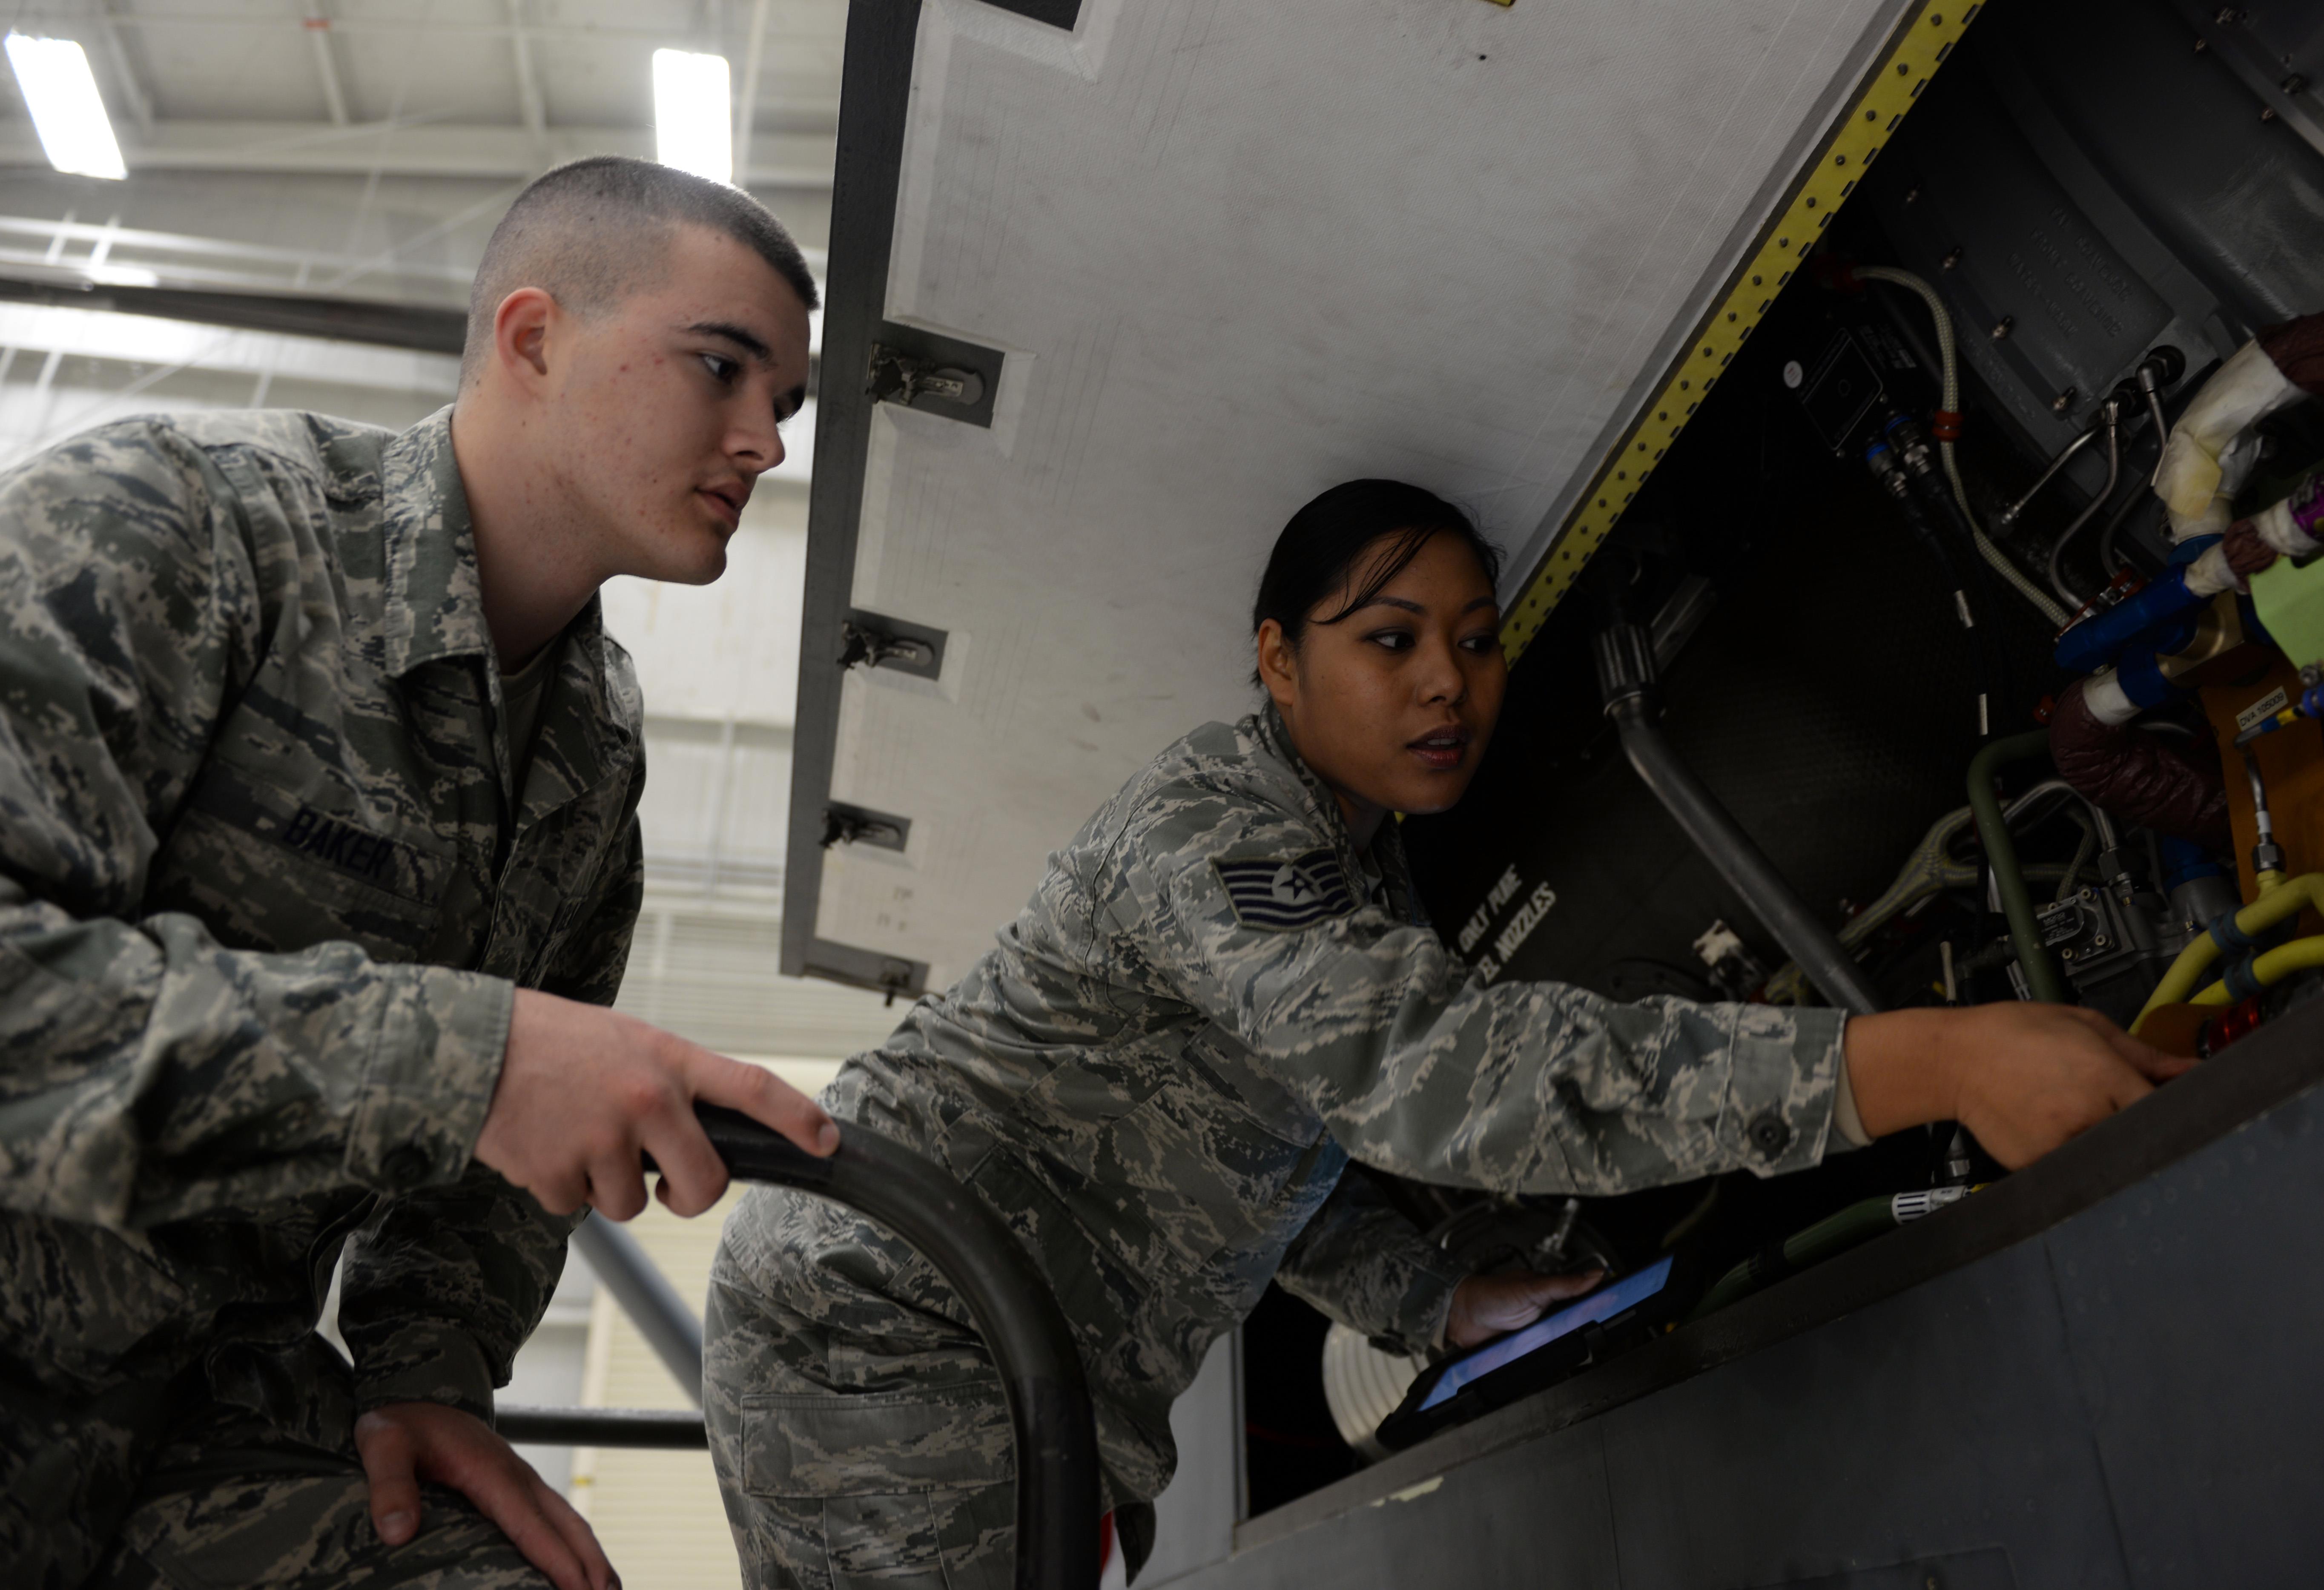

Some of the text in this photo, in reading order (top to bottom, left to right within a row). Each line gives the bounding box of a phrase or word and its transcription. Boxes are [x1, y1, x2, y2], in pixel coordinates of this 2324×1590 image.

[2240, 711, 2257, 727] DVA
[284, 806, 394, 879] BAKER
[1458, 901, 1490, 954] ONLY
[1477, 880, 1557, 984] EL NOZZLES
